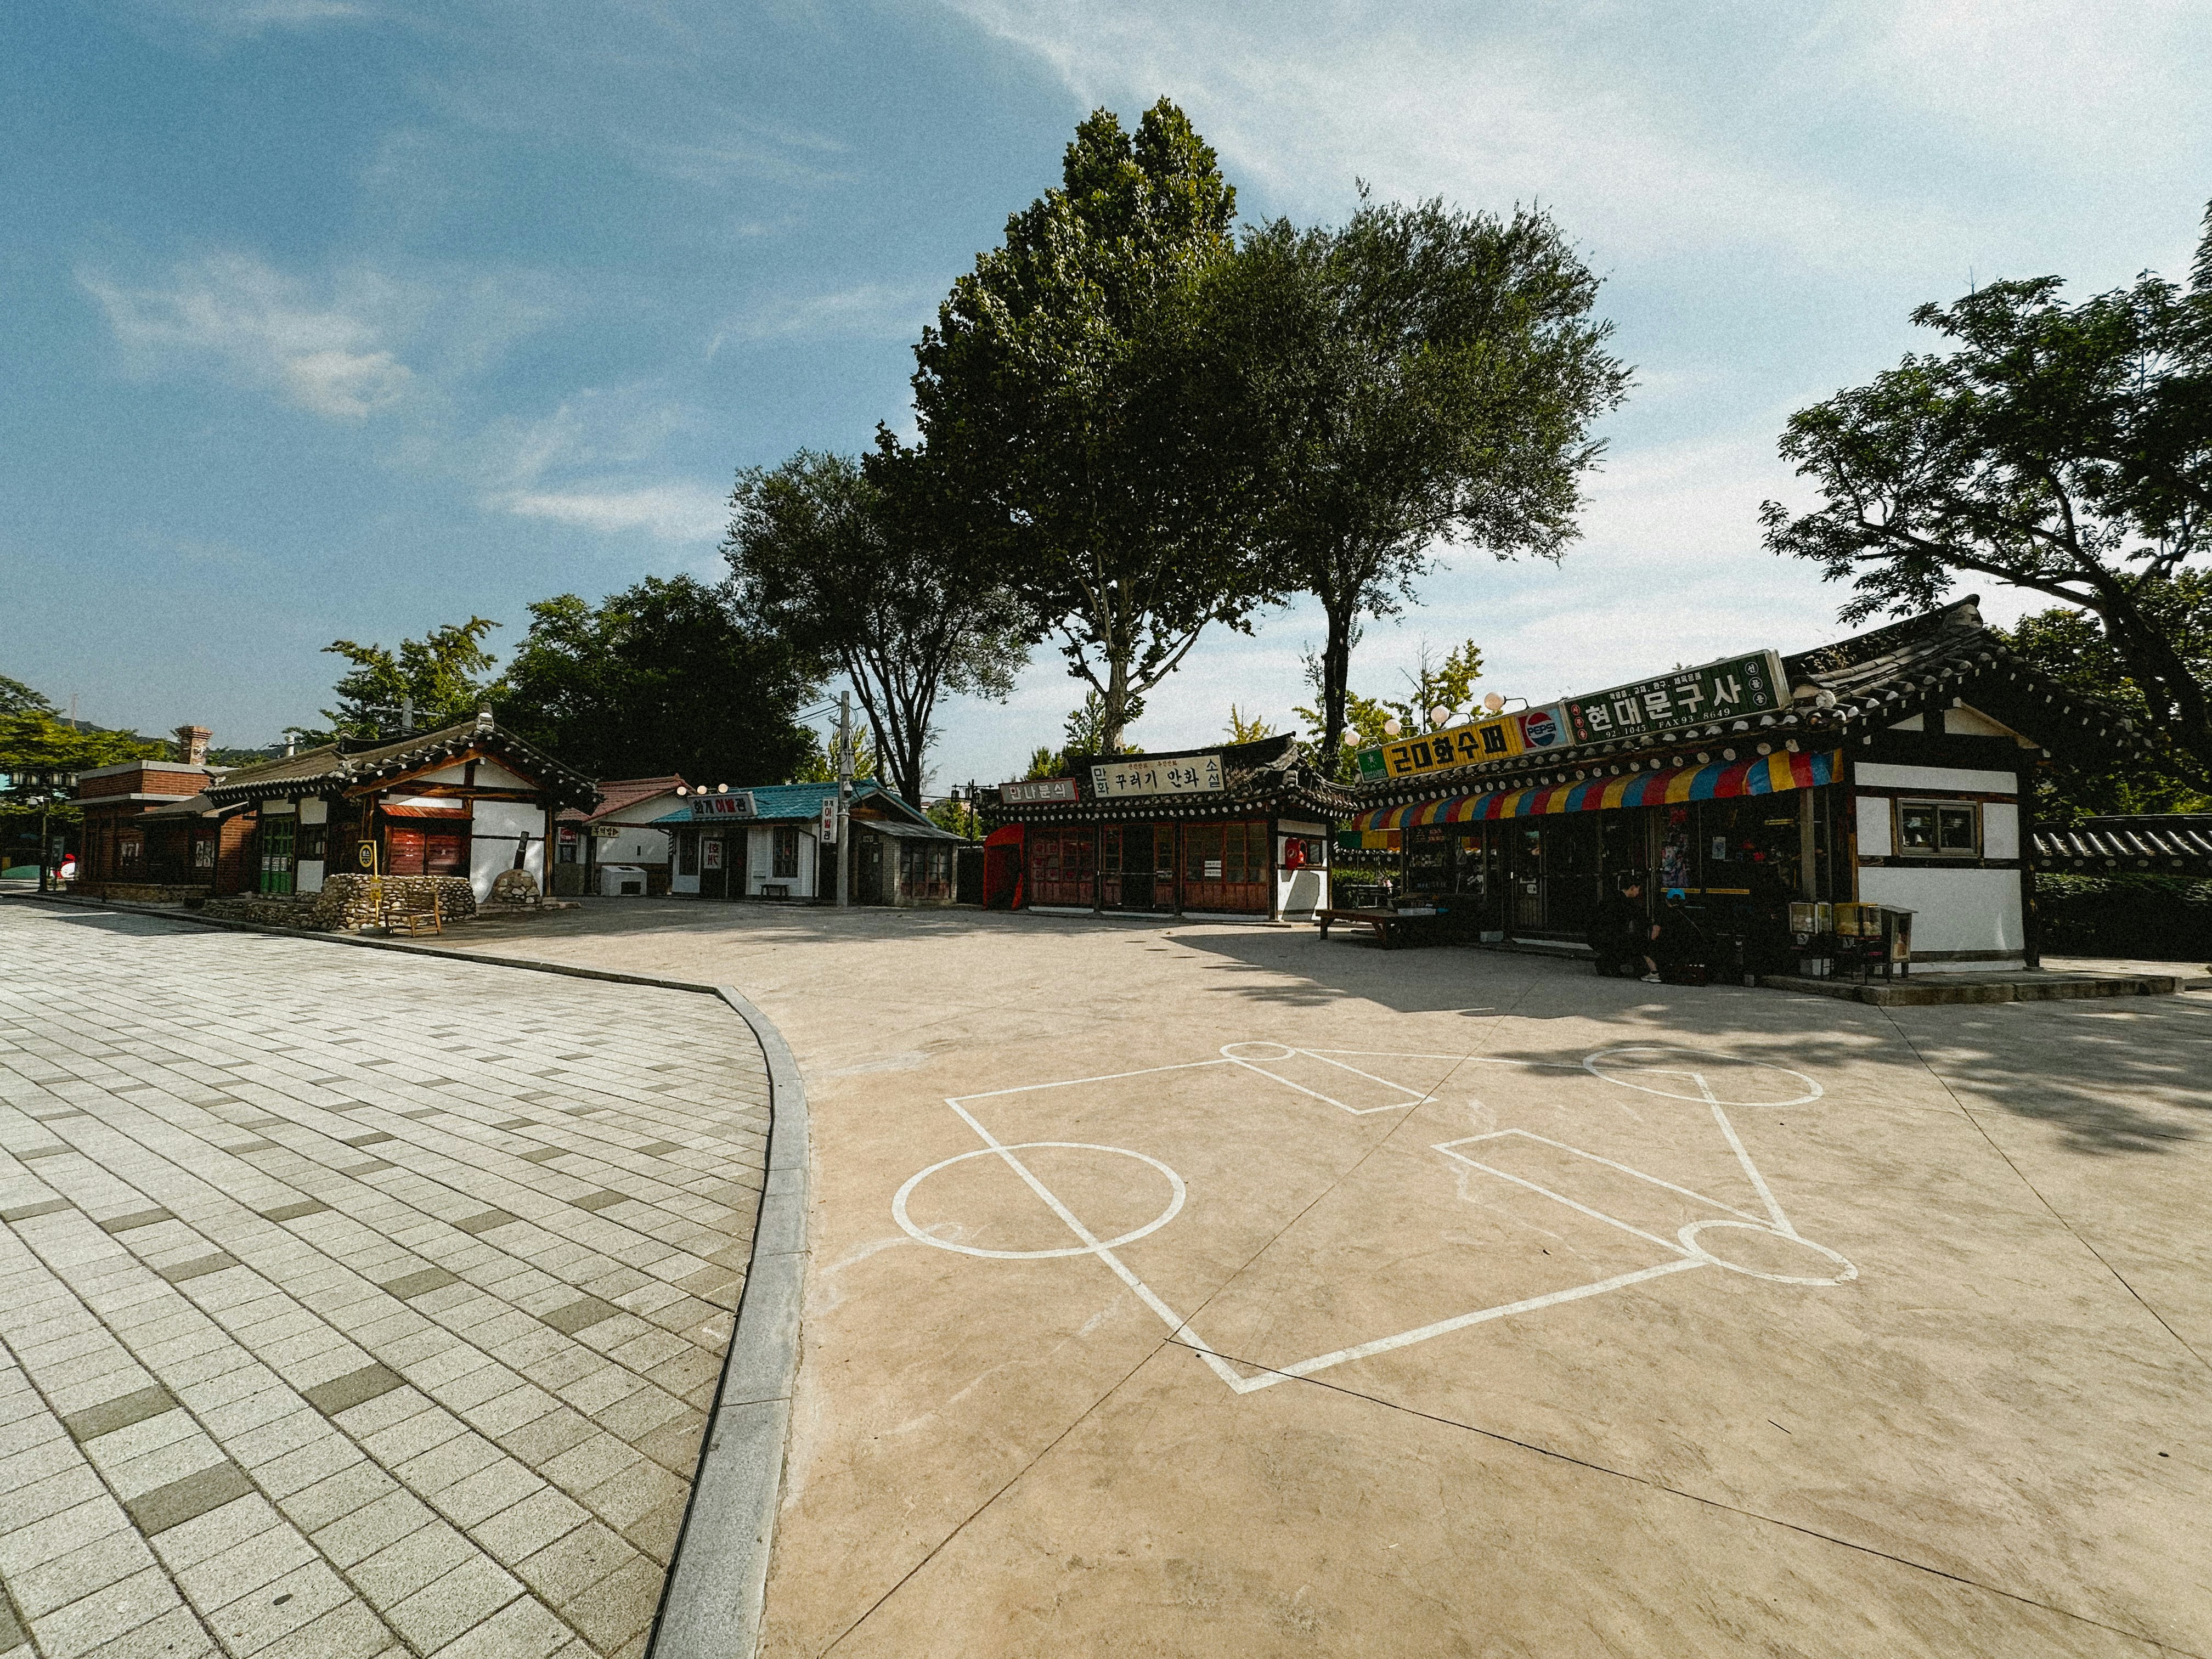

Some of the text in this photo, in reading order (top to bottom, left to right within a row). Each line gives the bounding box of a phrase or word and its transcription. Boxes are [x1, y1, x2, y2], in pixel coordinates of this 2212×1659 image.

[1585, 675, 1742, 732] 현대문구사
[1527, 722, 1557, 737] PEPSI
[1391, 724, 1508, 773] 근대화수퍼
[1094, 768, 1109, 794] 만화
[1115, 767, 1199, 790] 꾸러기 만화
[1206, 759, 1220, 788] 소설
[1009, 783, 1066, 800] 만나분식
[715, 797, 747, 813] 이발관
[823, 807, 832, 840] 이발관
